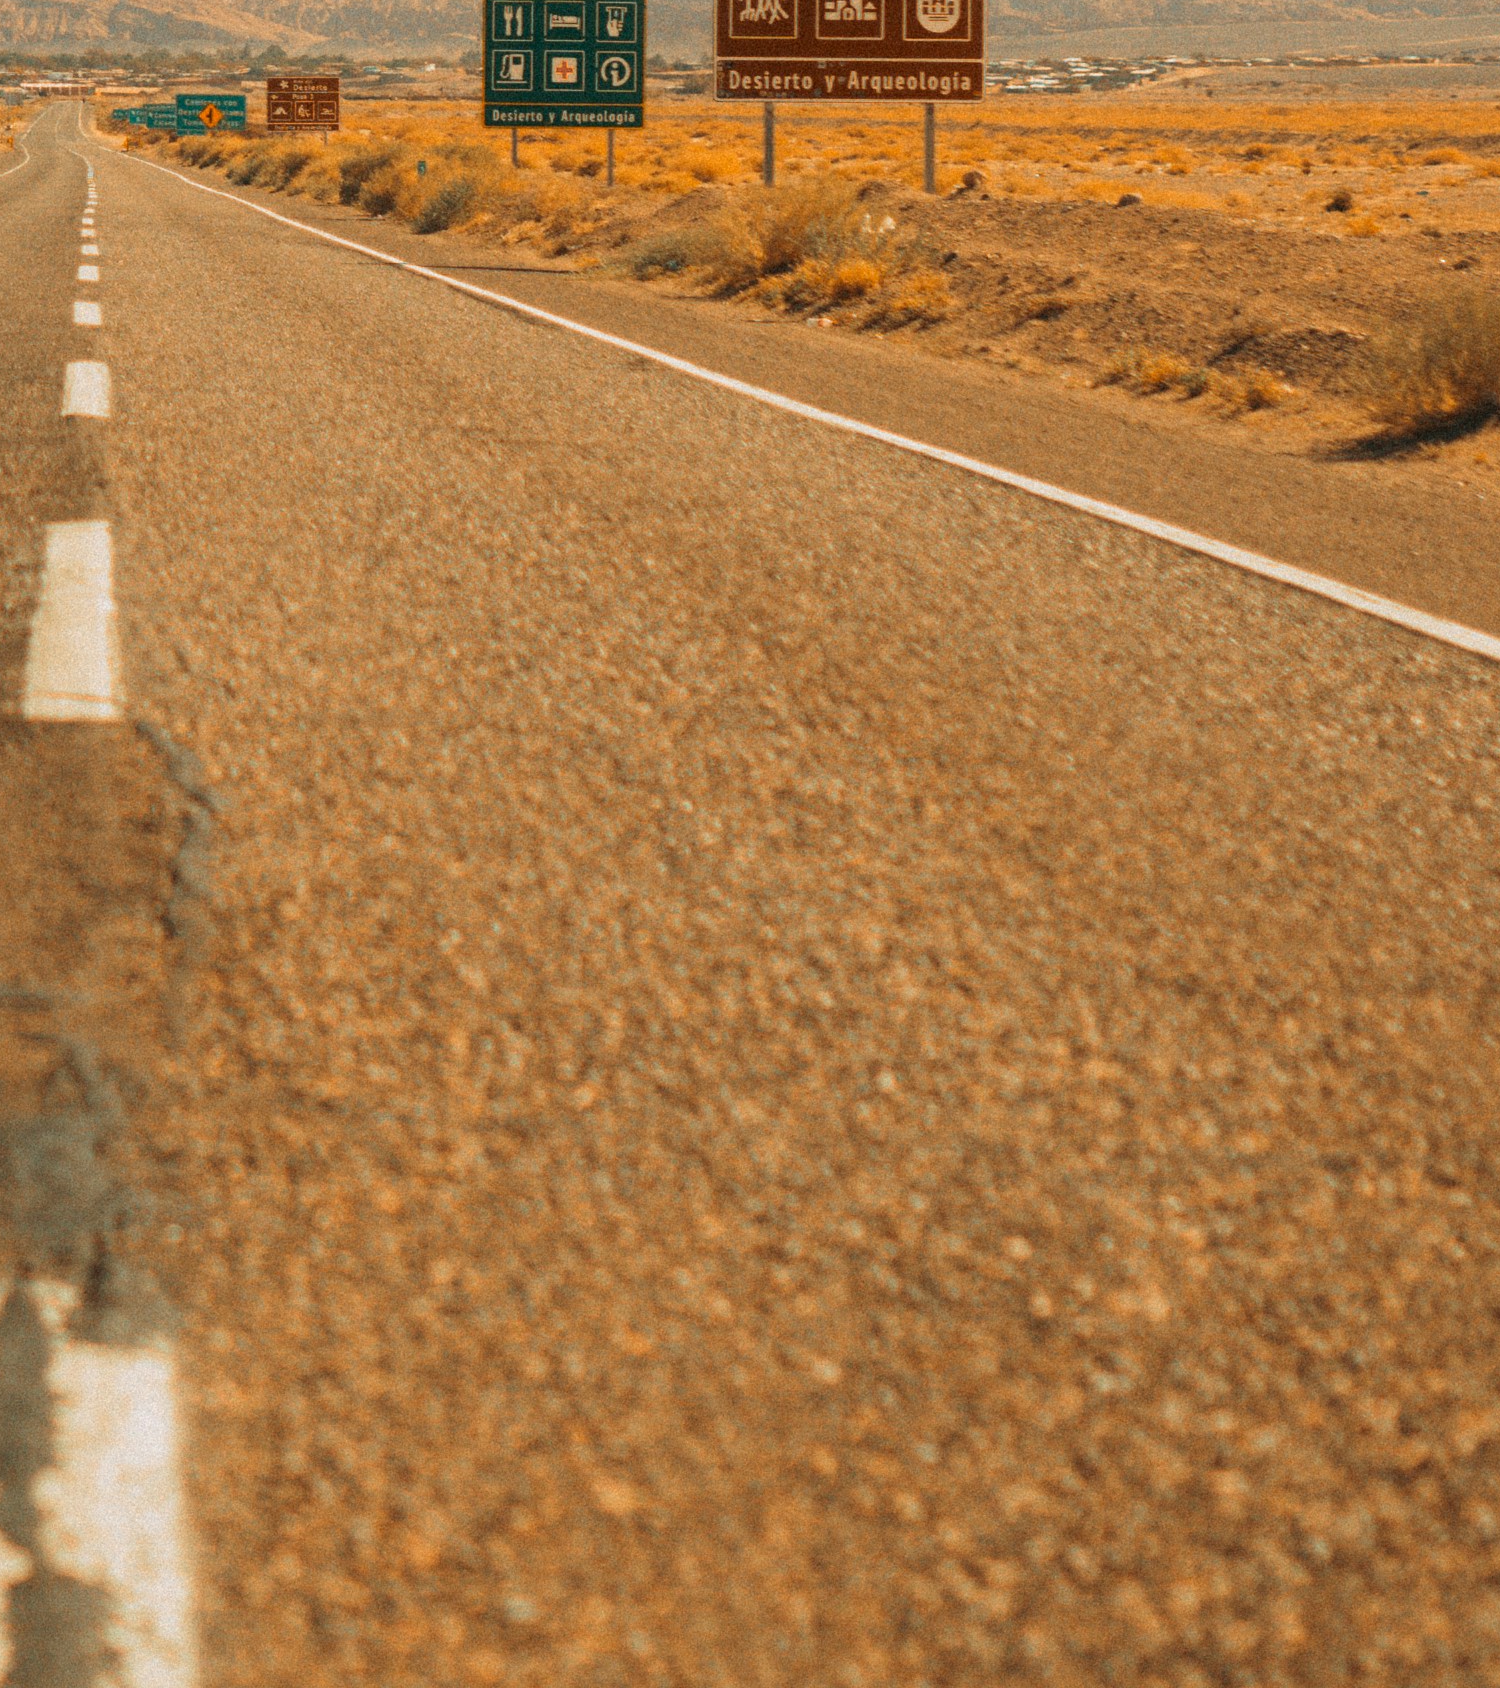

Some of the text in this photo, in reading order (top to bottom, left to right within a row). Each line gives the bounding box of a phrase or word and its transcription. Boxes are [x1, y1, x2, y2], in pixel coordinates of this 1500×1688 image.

[729, 70, 813, 90] Desierto
[825, 75, 836, 93] y
[492, 109, 544, 122] Desierto
[549, 112, 556, 123] y
